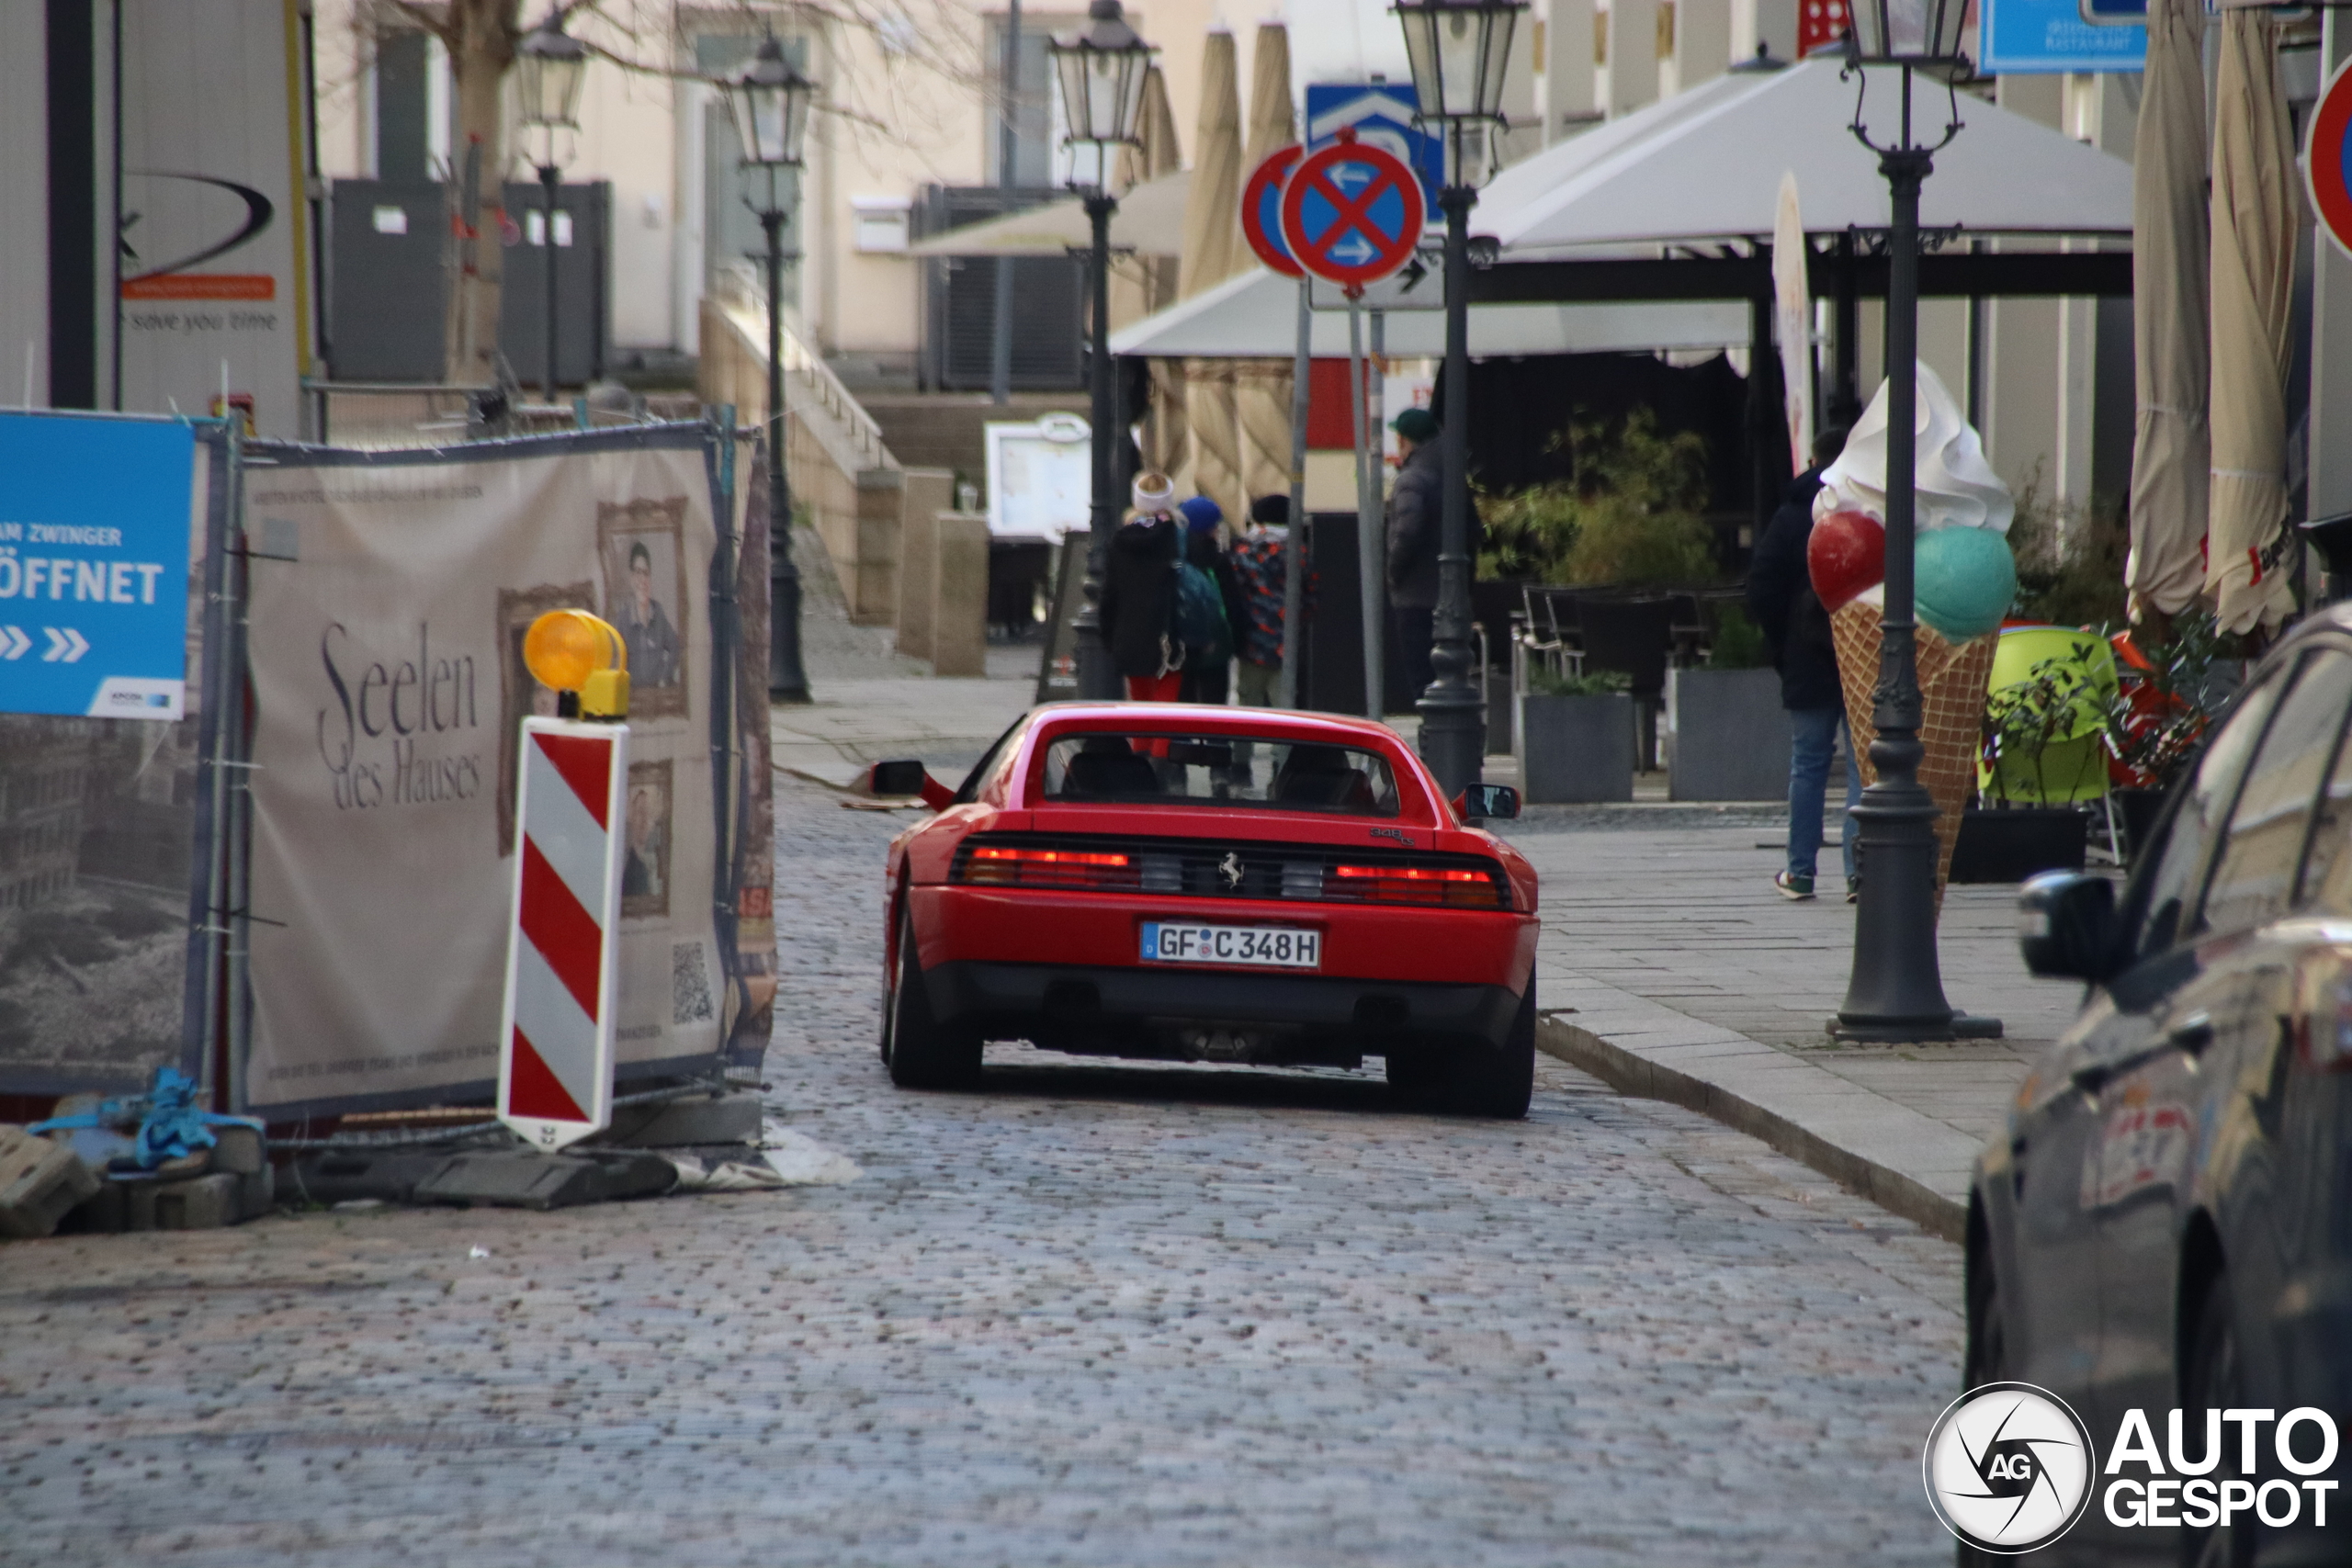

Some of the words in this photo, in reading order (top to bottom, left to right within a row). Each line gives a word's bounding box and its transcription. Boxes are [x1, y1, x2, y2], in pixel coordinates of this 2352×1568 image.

[131, 312, 179, 332] save
[182, 312, 223, 336] you
[230, 311, 278, 332] time
[28, 523, 123, 547] ZWINGER
[316, 616, 478, 775] Seelen
[333, 742, 383, 810] des
[392, 738, 481, 806] Hauses
[1370, 828, 1402, 840] 348
[1159, 929, 1197, 956] GF
